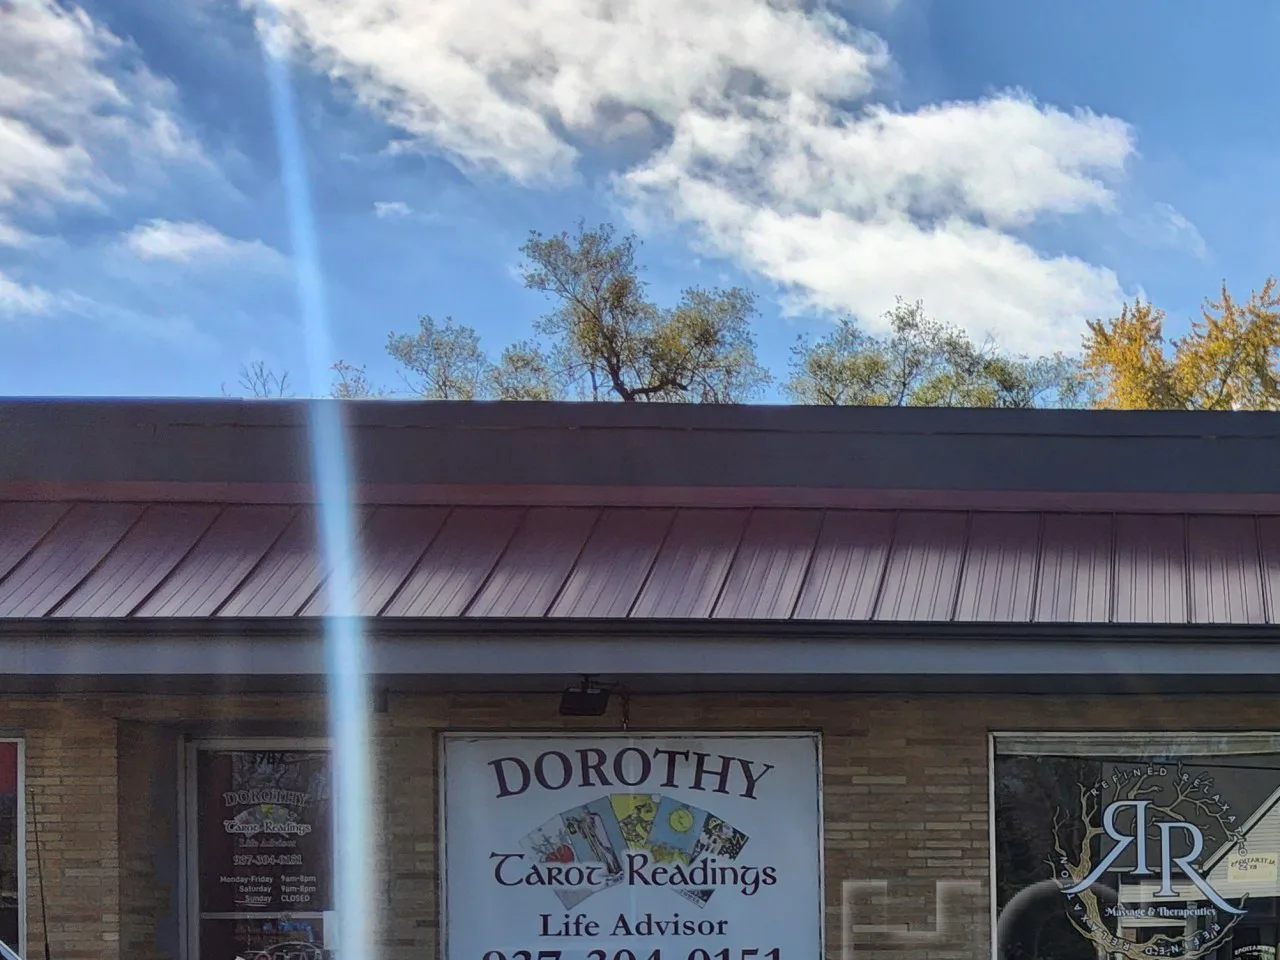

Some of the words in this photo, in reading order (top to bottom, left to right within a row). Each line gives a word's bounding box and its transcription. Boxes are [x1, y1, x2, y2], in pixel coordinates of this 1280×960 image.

[487, 747, 775, 799] DOROTHY
[1090, 766, 1168, 798] REFINED
[223, 787, 310, 807] DOROTHY
[223, 820, 260, 834] Tarot
[263, 819, 312, 836] Readings
[490, 852, 602, 887] Tarot
[628, 853, 777, 896] Readings
[239, 885, 272, 893] Saturday
[245, 895, 272, 903] Sunday
[280, 894, 310, 902] CLOSED
[1104, 906, 1146, 919] Massage
[1148, 907, 1156, 917] &
[1157, 905, 1216, 919] Therapeutics
[538, 913, 600, 937] Life
[610, 913, 729, 937] Advisor
